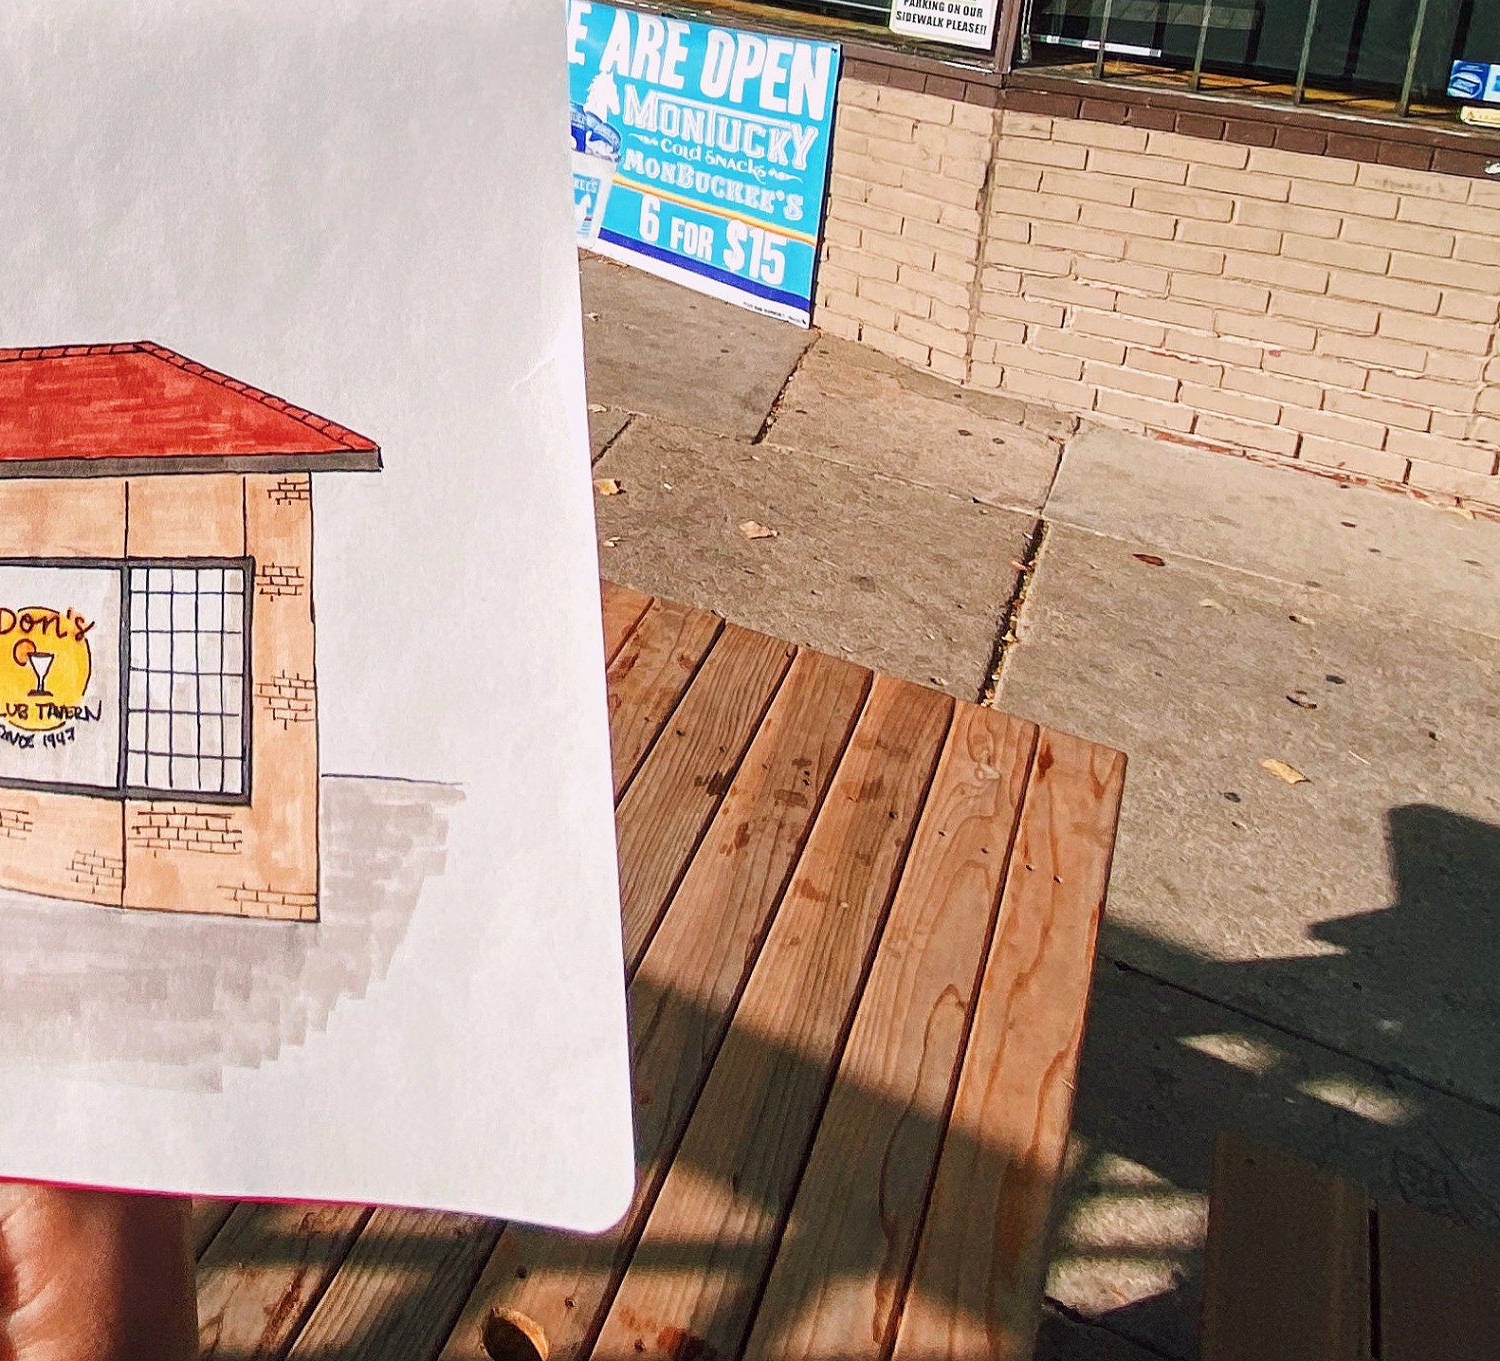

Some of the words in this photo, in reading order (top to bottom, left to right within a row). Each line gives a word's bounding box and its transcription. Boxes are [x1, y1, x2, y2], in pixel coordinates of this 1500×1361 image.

[896, 11, 944, 27] SIDEWALK
[946, 19, 987, 35] PLEASE!!
[947, 3, 961, 14] ON
[963, 6, 983, 18] OUR
[567, 4, 590, 66] E
[599, 9, 691, 90] ARE
[699, 28, 832, 121] OPEN
[623, 84, 819, 170] MONTUCKY
[638, 195, 660, 242] 6
[670, 216, 713, 262] FOR
[723, 217, 788, 287] $15
[35, 700, 102, 721] TAVERN
